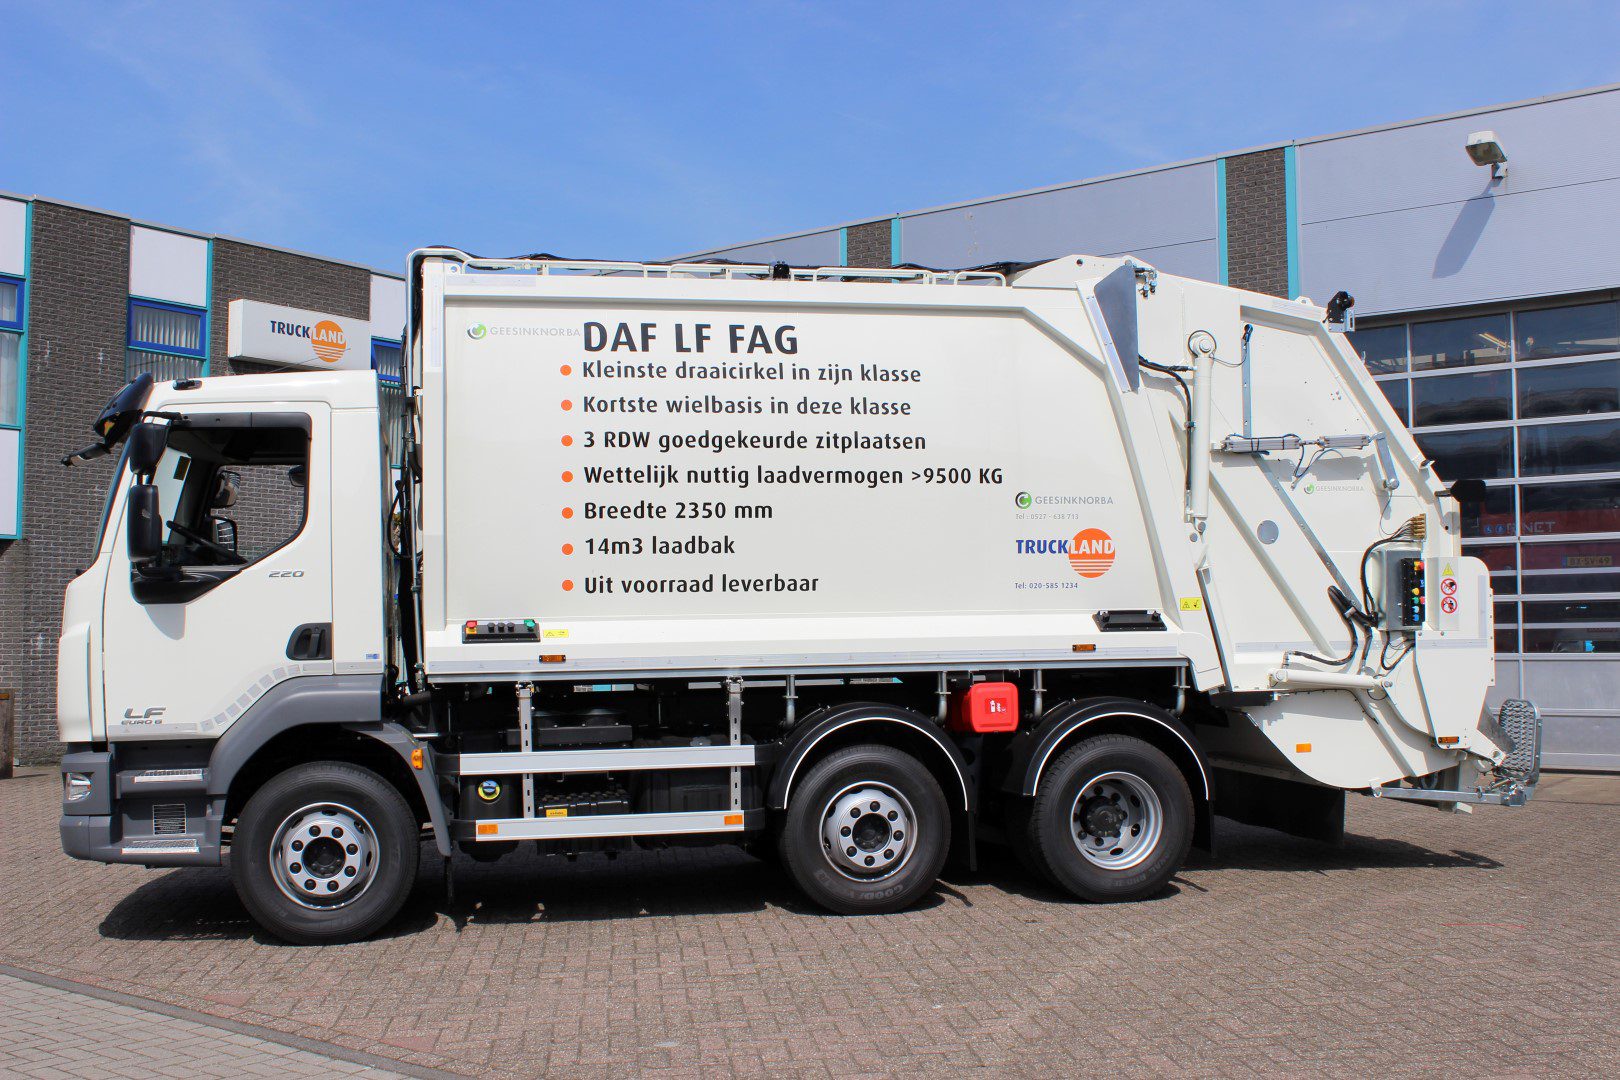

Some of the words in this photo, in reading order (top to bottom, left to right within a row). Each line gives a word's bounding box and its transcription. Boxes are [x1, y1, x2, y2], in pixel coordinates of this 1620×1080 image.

[270, 320, 347, 346] TRUCKLAND
[490, 326, 581, 337] GEESINKNORBA
[583, 321, 657, 353] DAF
[674, 323, 712, 353] LF
[728, 324, 798, 355] FAG
[583, 359, 667, 379] Kleinste
[675, 360, 784, 380] draaicirkel
[791, 363, 810, 381] in
[817, 363, 853, 386] zijn
[860, 363, 921, 383] klasse
[583, 395, 658, 413] Kortste
[665, 395, 763, 414] wielbasis
[770, 396, 789, 414] in
[796, 396, 843, 415] deze
[850, 396, 911, 416] klasse
[583, 430, 595, 448] 3
[604, 431, 651, 448] RDW
[658, 429, 808, 454] goedgekeurde
[815, 430, 926, 454] zitplaatsen
[583, 464, 679, 489] Wettelijk
[687, 465, 749, 489] nuttig
[757, 464, 903, 489] laadvermogen
[911, 467, 972, 485] >9500
[979, 467, 1003, 485] KG
[584, 500, 667, 520] Breedte
[675, 501, 727, 519] 2350
[734, 505, 773, 519] mm
[1035, 496, 1114, 505] GEESINKNORBA
[585, 537, 643, 555] 14m3
[652, 535, 736, 555] laadbak
[1015, 539, 1115, 554] TRUCKLAND
[268, 570, 305, 578] 220
[584, 575, 614, 594] Uit
[620, 573, 714, 594] voorraad
[722, 573, 819, 593] leverbaar
[124, 706, 166, 719] LF
